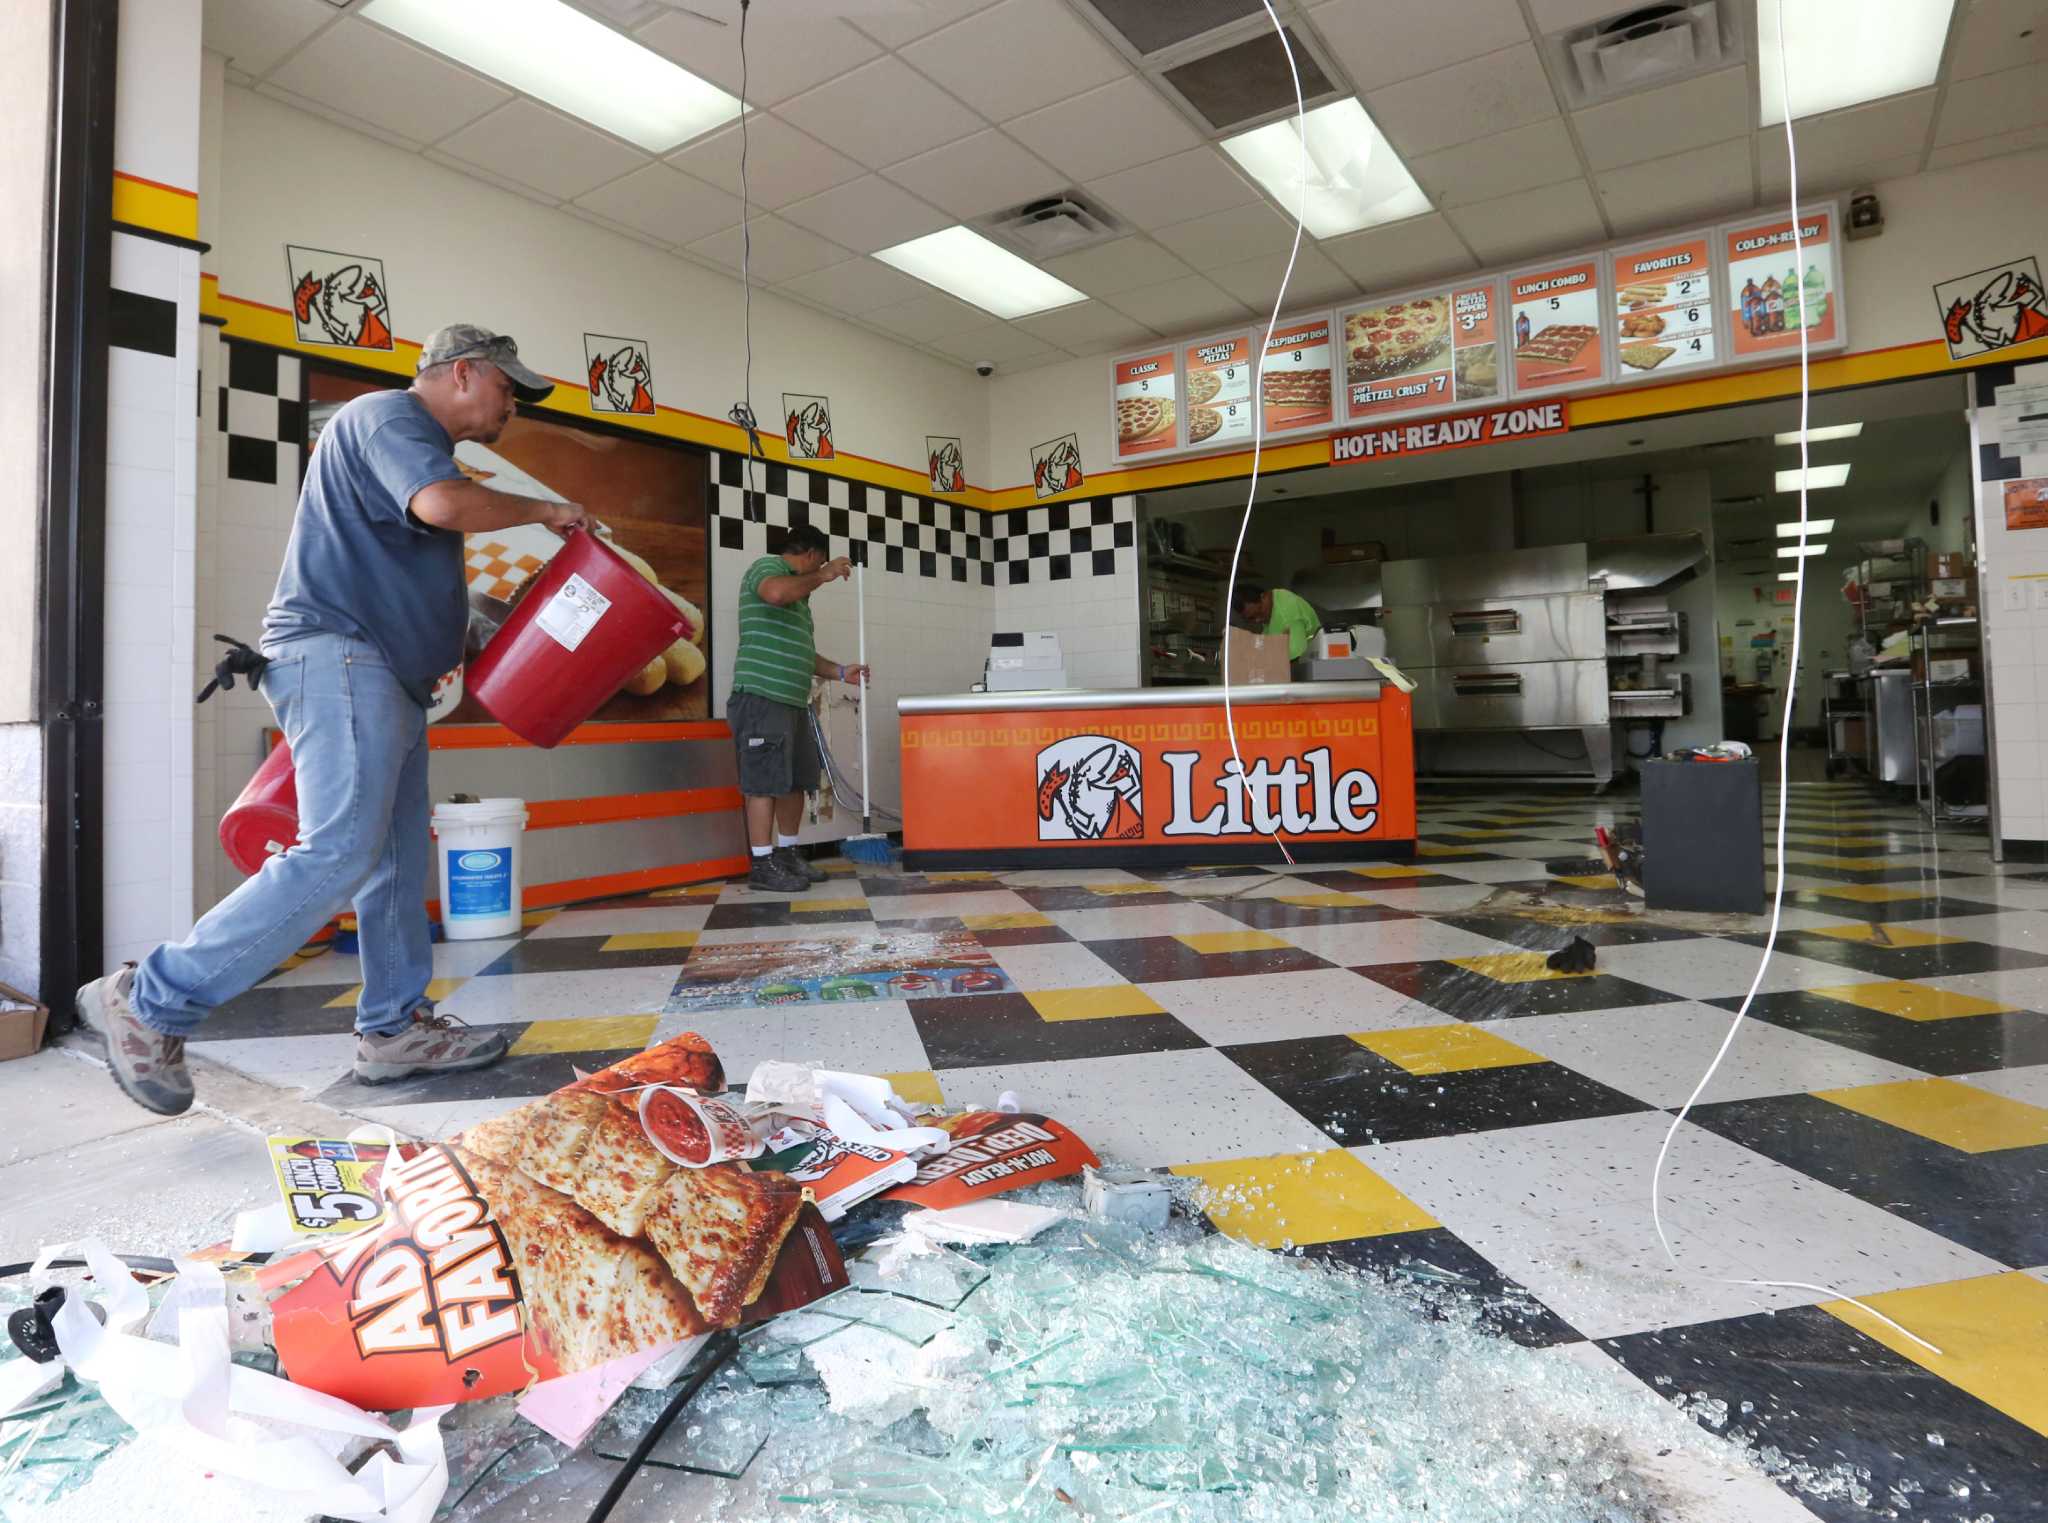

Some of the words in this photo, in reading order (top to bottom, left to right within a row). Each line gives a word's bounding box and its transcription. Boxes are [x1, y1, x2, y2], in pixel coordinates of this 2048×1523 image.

[1634, 253, 1691, 274] FAVORITES
[1517, 281, 1549, 295] LUNCH
[1550, 273, 1586, 288] COMBO
[1311, 328, 1328, 340] DISH
[1197, 343, 1235, 358] SPECIALTY
[1203, 351, 1230, 364] PIZZAS
[1130, 362, 1159, 375] CLASSIC
[1353, 389, 1393, 404] PRETZEL
[1396, 383, 1427, 397] CRUST
[1334, 416, 1484, 460] HOT-N-READY
[1491, 404, 1563, 437] ZONE
[1161, 747, 1379, 838] Little
[288, 1159, 321, 1191] LUNCH
[311, 1158, 344, 1193] COMBO
[959, 1149, 1057, 1187] HOT-N-READY
